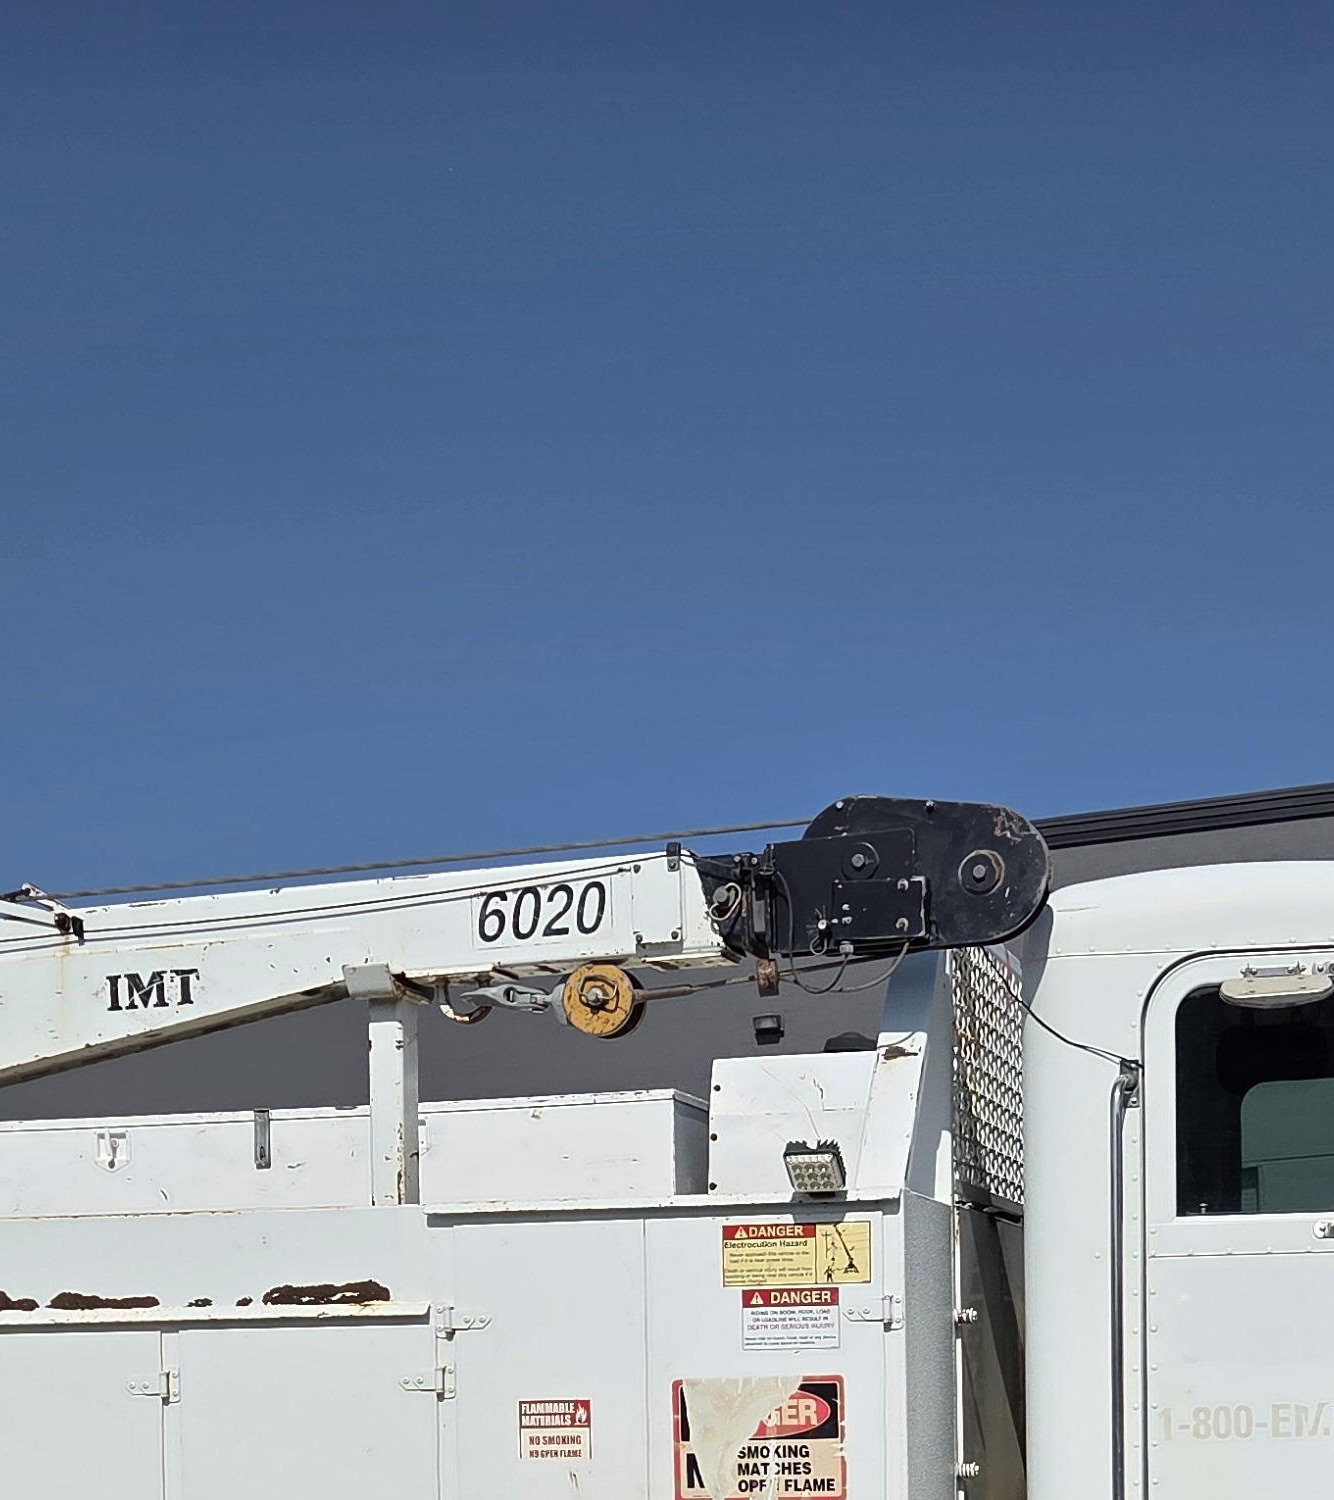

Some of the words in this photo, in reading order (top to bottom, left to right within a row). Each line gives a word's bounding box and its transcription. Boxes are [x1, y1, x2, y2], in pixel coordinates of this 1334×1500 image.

[477, 880, 608, 943] 6020
[106, 968, 200, 1011] IMT
[748, 1225, 804, 1237] DANGER
[724, 1240, 777, 1249] Electrocution
[770, 1290, 832, 1304] DANGER
[521, 1402, 575, 1415] FLAMMABLE
[521, 1414, 572, 1426] MATERIALS
[529, 1436, 541, 1445] NO
[542, 1435, 582, 1445] SMOKING
[529, 1450, 540, 1458] NO
[540, 1450, 559, 1458] OPEN
[560, 1449, 582, 1458] FLAME
[737, 1444, 810, 1459] SMOKING
[784, 1478, 836, 1492] FLAME
